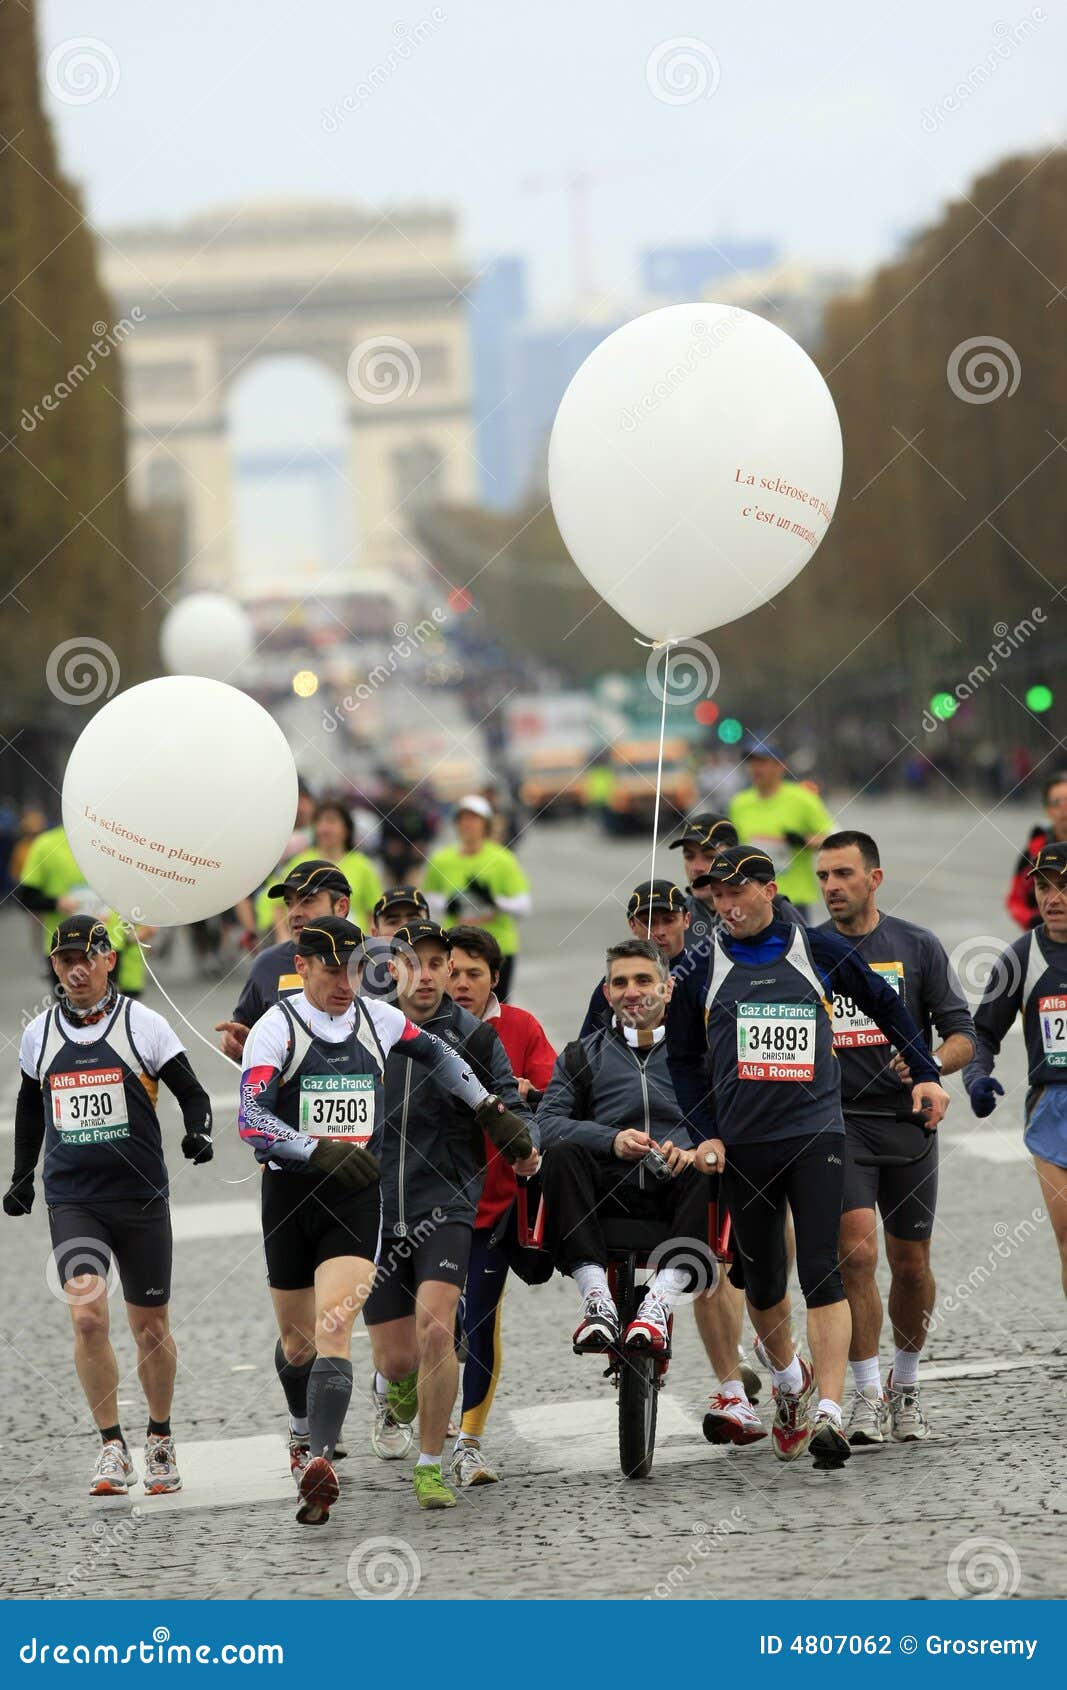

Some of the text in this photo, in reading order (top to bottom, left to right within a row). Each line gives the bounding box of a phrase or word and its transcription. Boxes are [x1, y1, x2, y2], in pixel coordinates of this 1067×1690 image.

[735, 469, 755, 485] La
[760, 478, 808, 502] sclérose
[809, 496, 819, 509] en
[776, 517, 791, 530] un
[84, 806, 222, 869] La sclérose en plaques
[118, 852, 133, 865] un
[135, 860, 197, 886] marathon
[1043, 998, 1066, 1009] Alfa
[739, 1004, 814, 1017] Gaz de France
[850, 1018, 874, 1027] PHILIPP
[749, 1025, 808, 1051] 34893
[833, 1033, 888, 1046] Alfa Rom
[762, 1052, 795, 1061] CHRISTIAN
[1047, 1054, 1066, 1065] Gaz
[741, 1064, 764, 1077] Alfa
[53, 1073, 119, 1088] Alfa Romeo
[302, 1078, 372, 1090] Gaz de France
[69, 1092, 113, 1119] 3730
[313, 1098, 367, 1124] 37503
[80, 1118, 106, 1128] PATRICK
[327, 1124, 355, 1133] PHILIPPE
[61, 1127, 129, 1144] Gaz de France
